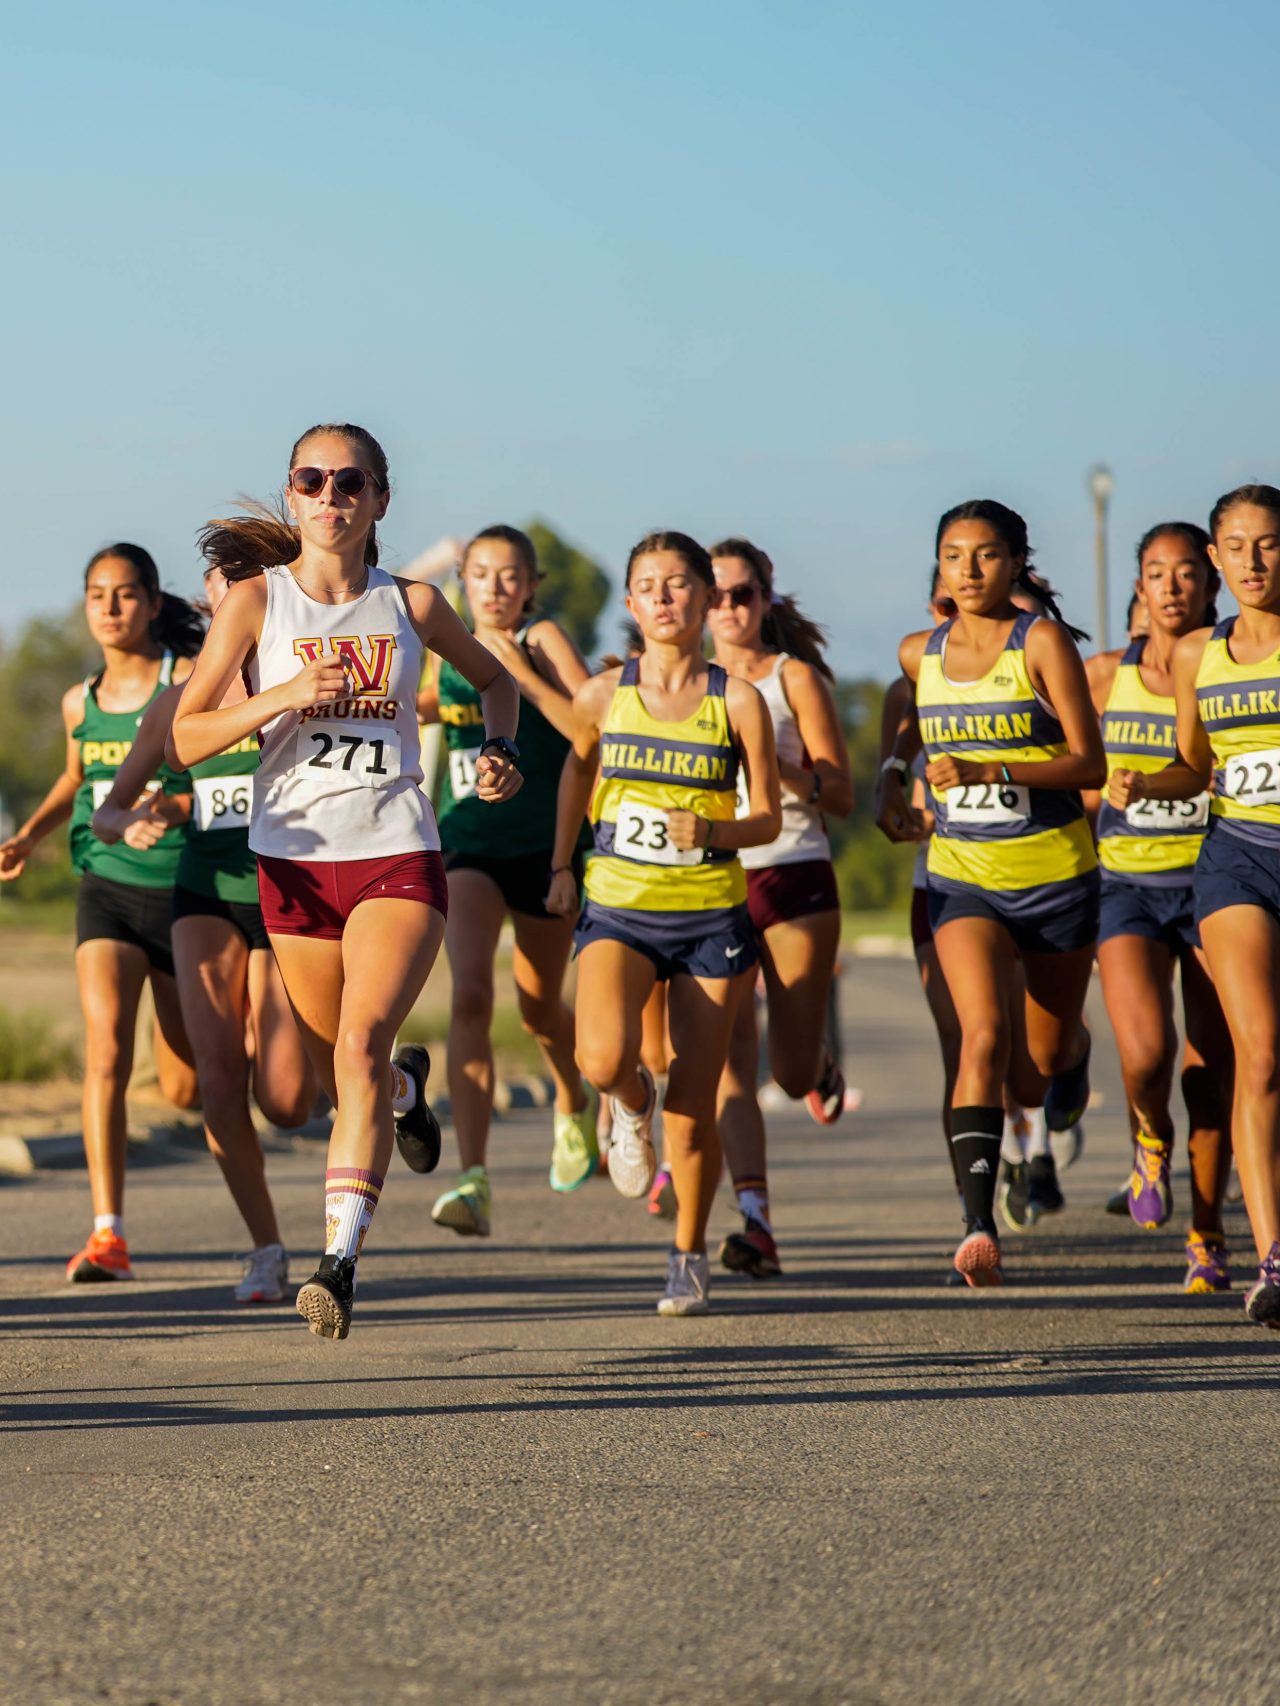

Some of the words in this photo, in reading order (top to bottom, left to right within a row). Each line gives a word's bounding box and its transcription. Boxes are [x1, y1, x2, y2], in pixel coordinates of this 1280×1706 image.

[1198, 689, 1280, 722] MILLIK
[1104, 720, 1177, 748] MILLI
[308, 733, 388, 775] 271
[602, 743, 728, 781] MILLIKAN
[1234, 762, 1280, 796] 22
[212, 787, 249, 816] 86
[626, 816, 684, 853] 23
